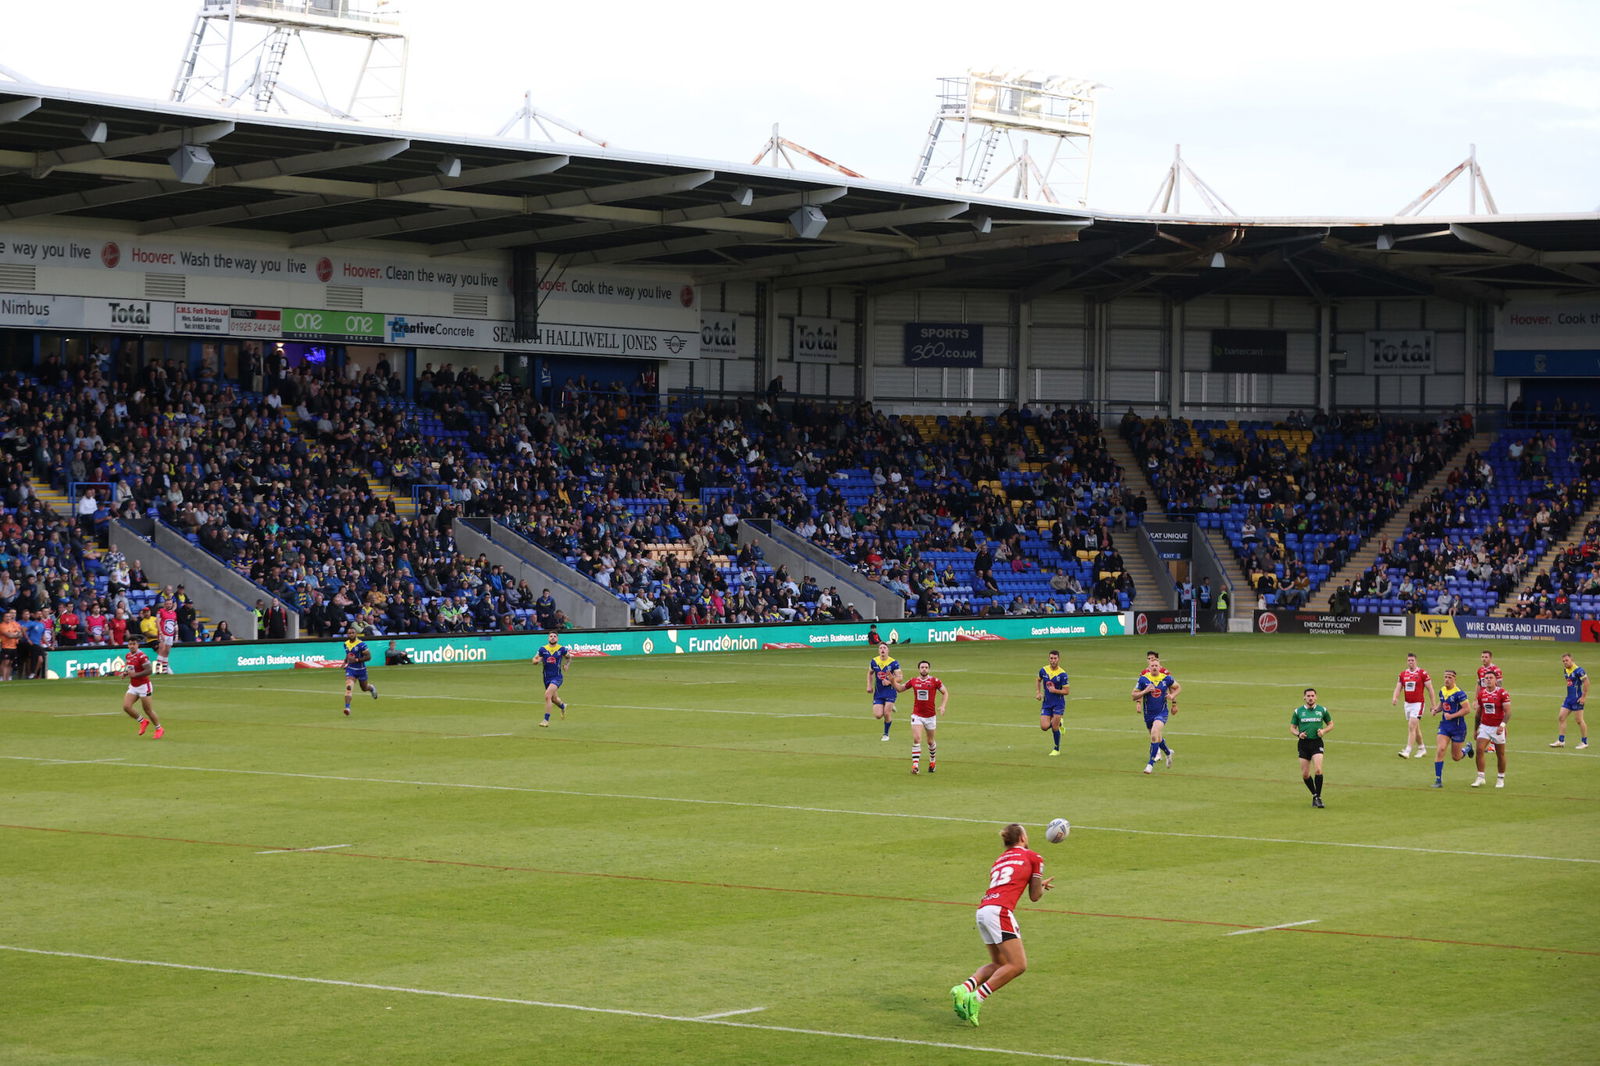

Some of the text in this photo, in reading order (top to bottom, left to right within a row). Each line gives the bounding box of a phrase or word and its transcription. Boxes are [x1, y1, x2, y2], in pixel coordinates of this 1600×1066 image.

[13, 242, 38, 259] way
[42, 245, 64, 260] you
[70, 243, 91, 259] live
[180, 251, 210, 268] Wash
[214, 254, 232, 268] the
[235, 258, 257, 273] way
[261, 261, 281, 274] you
[287, 259, 307, 274] live
[386, 265, 414, 280] Clean
[418, 268, 434, 282] the
[437, 273, 457, 287] way
[461, 275, 478, 288] you
[480, 273, 498, 287] live
[572, 281, 595, 295] Cook
[598, 282, 614, 296] the
[617, 285, 635, 299] way
[638, 287, 654, 301] you
[656, 286, 672, 300] live
[2, 300, 50, 316] Nimbus
[109, 302, 151, 325] Total
[294, 313, 322, 331] one
[346, 316, 374, 333] one
[1558, 312, 1585, 324] Cook
[254, 323, 266, 332] 244
[267, 324, 281, 332] 244
[701, 319, 736, 346] otal
[921, 328, 969, 339] SPORTS
[493, 326, 656, 354] SEAH HALLIWELL JONES
[797, 324, 838, 351] Total
[1370, 336, 1431, 362] Total
[1163, 532, 1188, 540] UNIQUE
[809, 633, 830, 643] Search
[830, 632, 853, 642] Business
[1031, 625, 1086, 637] Search Business Loans
[1466, 622, 1576, 635] WIRE CRANES AND LIFTING LTD
[602, 643, 622, 652] Loans
[689, 634, 758, 652] FundOnion
[237, 656, 265, 666] Search
[266, 655, 300, 664] Business
[990, 866, 1015, 888] 23
